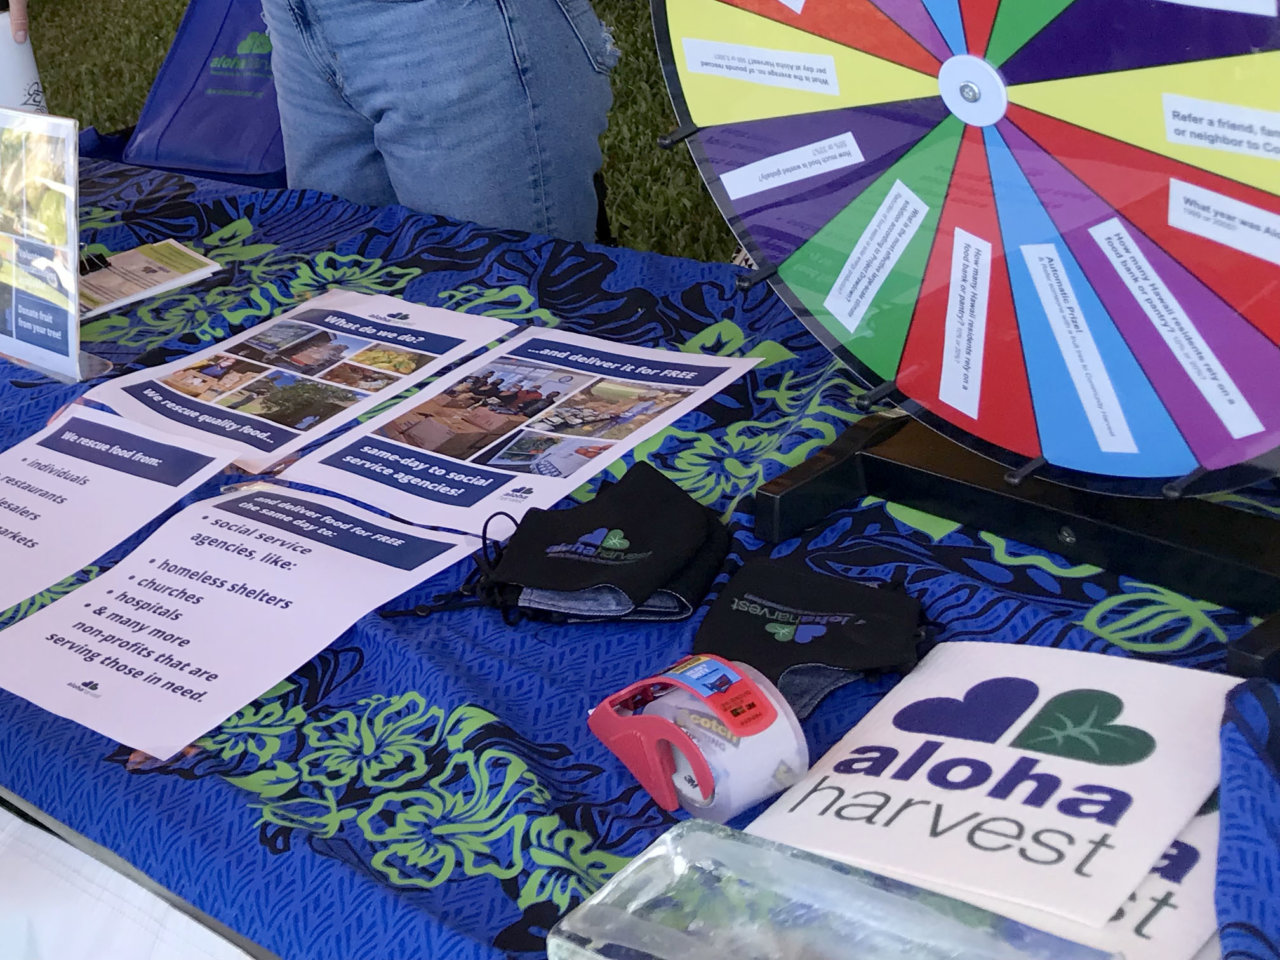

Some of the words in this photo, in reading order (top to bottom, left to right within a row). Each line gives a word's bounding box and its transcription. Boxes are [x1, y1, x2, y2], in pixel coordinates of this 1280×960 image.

[17, 304, 39, 320] Donate
[39, 310, 53, 324] fruit
[17, 319, 32, 332] from
[31, 323, 48, 337] your
[47, 326, 62, 340] tree!
[323, 314, 356, 330] What
[358, 325, 377, 334] do
[376, 329, 396, 339] we
[396, 333, 425, 344] do?
[567, 353, 620, 369] deliver
[619, 362, 635, 372] it
[634, 365, 660, 375] for
[658, 368, 698, 379] FREE
[142, 387, 163, 401] We
[160, 399, 200, 418] rescue
[197, 414, 240, 431] quality
[60, 430, 78, 442] We
[75, 436, 110, 451] rescue
[107, 444, 136, 458] food
[130, 451, 162, 466] from:
[360, 445, 429, 470] same-day
[427, 465, 446, 475] to
[445, 471, 493, 486] social
[0, 475, 67, 504] restaurants
[27, 459, 89, 485] individuals
[342, 455, 393, 475] service
[393, 471, 464, 496] agencies!
[210, 518, 258, 536] social
[254, 532, 312, 555] service
[237, 501, 260, 511] the
[258, 508, 293, 522] same
[292, 518, 317, 531] day
[316, 527, 337, 537] to:
[277, 501, 320, 518] deliver
[319, 515, 350, 529] food
[349, 526, 372, 536] for
[370, 533, 405, 546] FREE
[191, 532, 256, 557] agencies,
[259, 552, 297, 570] like:
[136, 577, 204, 604] churches
[157, 558, 227, 588] homeless
[226, 582, 292, 609] shelters
[114, 590, 182, 621] hospitals
[91, 605, 108, 616] &
[106, 611, 150, 633] many
[147, 627, 190, 647] more
[45, 633, 101, 662] serving
[99, 655, 144, 678] those
[142, 671, 161, 685] in
[160, 680, 207, 702] need.
[73, 621, 154, 658] non-profits
[153, 652, 191, 671] that
[187, 666, 218, 682] are
[833, 740, 1134, 826] aloha
[787, 775, 1116, 878] harvest
